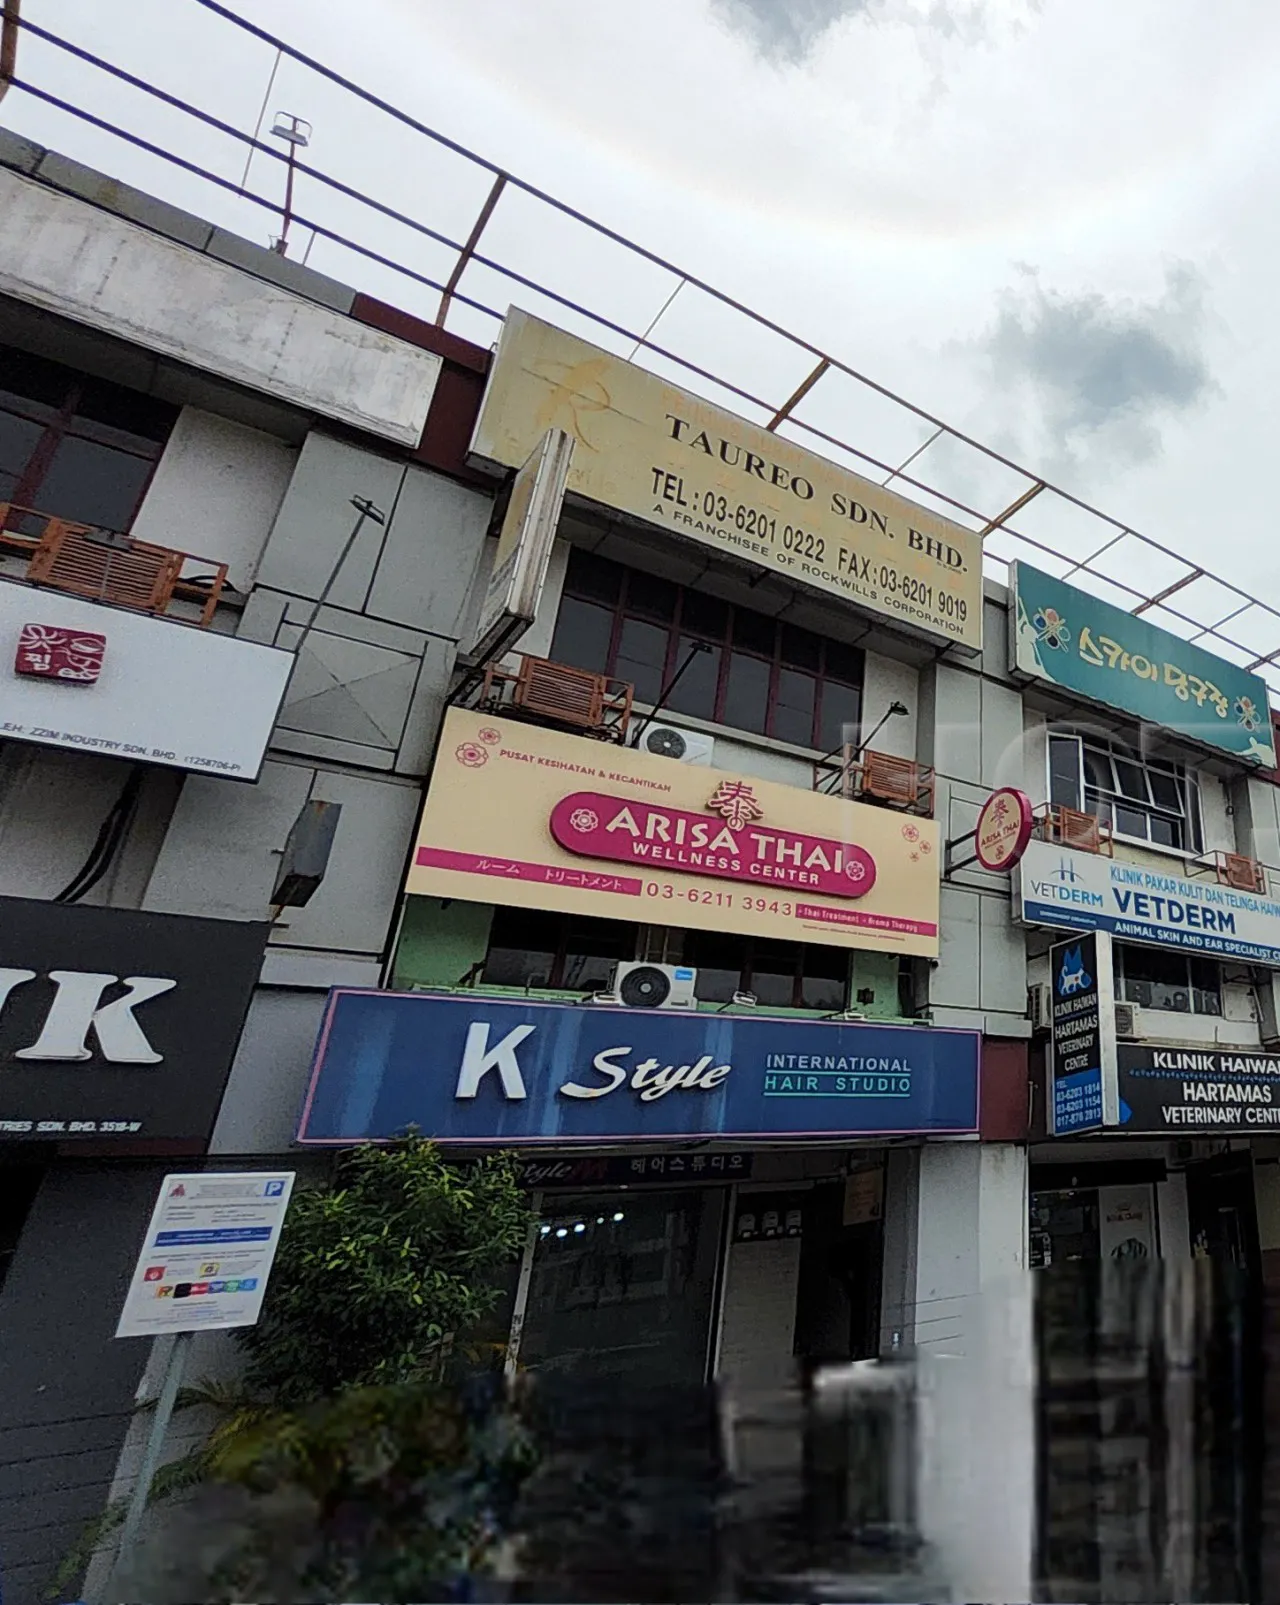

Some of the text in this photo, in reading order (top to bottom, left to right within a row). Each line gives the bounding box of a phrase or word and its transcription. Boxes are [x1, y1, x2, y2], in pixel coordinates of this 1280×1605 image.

[665, 413, 968, 573] TAUREO SDN. BHD.
[653, 504, 964, 635] A FRANCHISEE OF ROCKWILLS CORPORATION
[783, 525, 825, 563] 0222
[938, 591, 967, 621] 9019
[1079, 627, 1229, 718] 스카이 당구장
[63, 733, 121, 750] INDUSTRY
[123, 744, 148, 755] SDN.
[152, 748, 178, 760] BHD.
[500, 749, 535, 763] PUSAT
[537, 757, 595, 776] KESIHATAN
[609, 773, 672, 792] KECANTIKAN
[606, 807, 842, 873] ARISA THAI
[476, 859, 520, 875] ルーム
[632, 842, 819, 885] WELLNESS CENTER
[646, 883, 792, 916] 03-6211 3943
[1030, 880, 1104, 907] VETDERM
[1110, 865, 1143, 886] KLINIK
[1145, 874, 1176, 893] PAKAR
[1178, 881, 1202, 901] KULIT
[1205, 888, 1223, 904] DAN
[1224, 892, 1259, 911] TELINGA
[1112, 887, 1236, 935] VETDERM
[1115, 921, 1155, 938] ANIMAL
[1158, 929, 1180, 943] SKIN
[1182, 933, 1202, 947] AND
[1205, 937, 1223, 951] EAR
[1224, 941, 1272, 960] SPECIALIST
[1055, 1015, 1098, 1039] HARTAMAS
[1058, 1034, 1094, 1055] VETERINARY
[1153, 1051, 1215, 1071] KLINIK
[456, 1022, 732, 1102] K Style
[766, 1054, 911, 1072] INTERNATIONAL
[1064, 1054, 1089, 1071] CENTRE
[764, 1075, 911, 1092] HAIR STUDIO
[1183, 1081, 1272, 1103] HARTAMAS
[1162, 1106, 1242, 1124] VETERINARY
